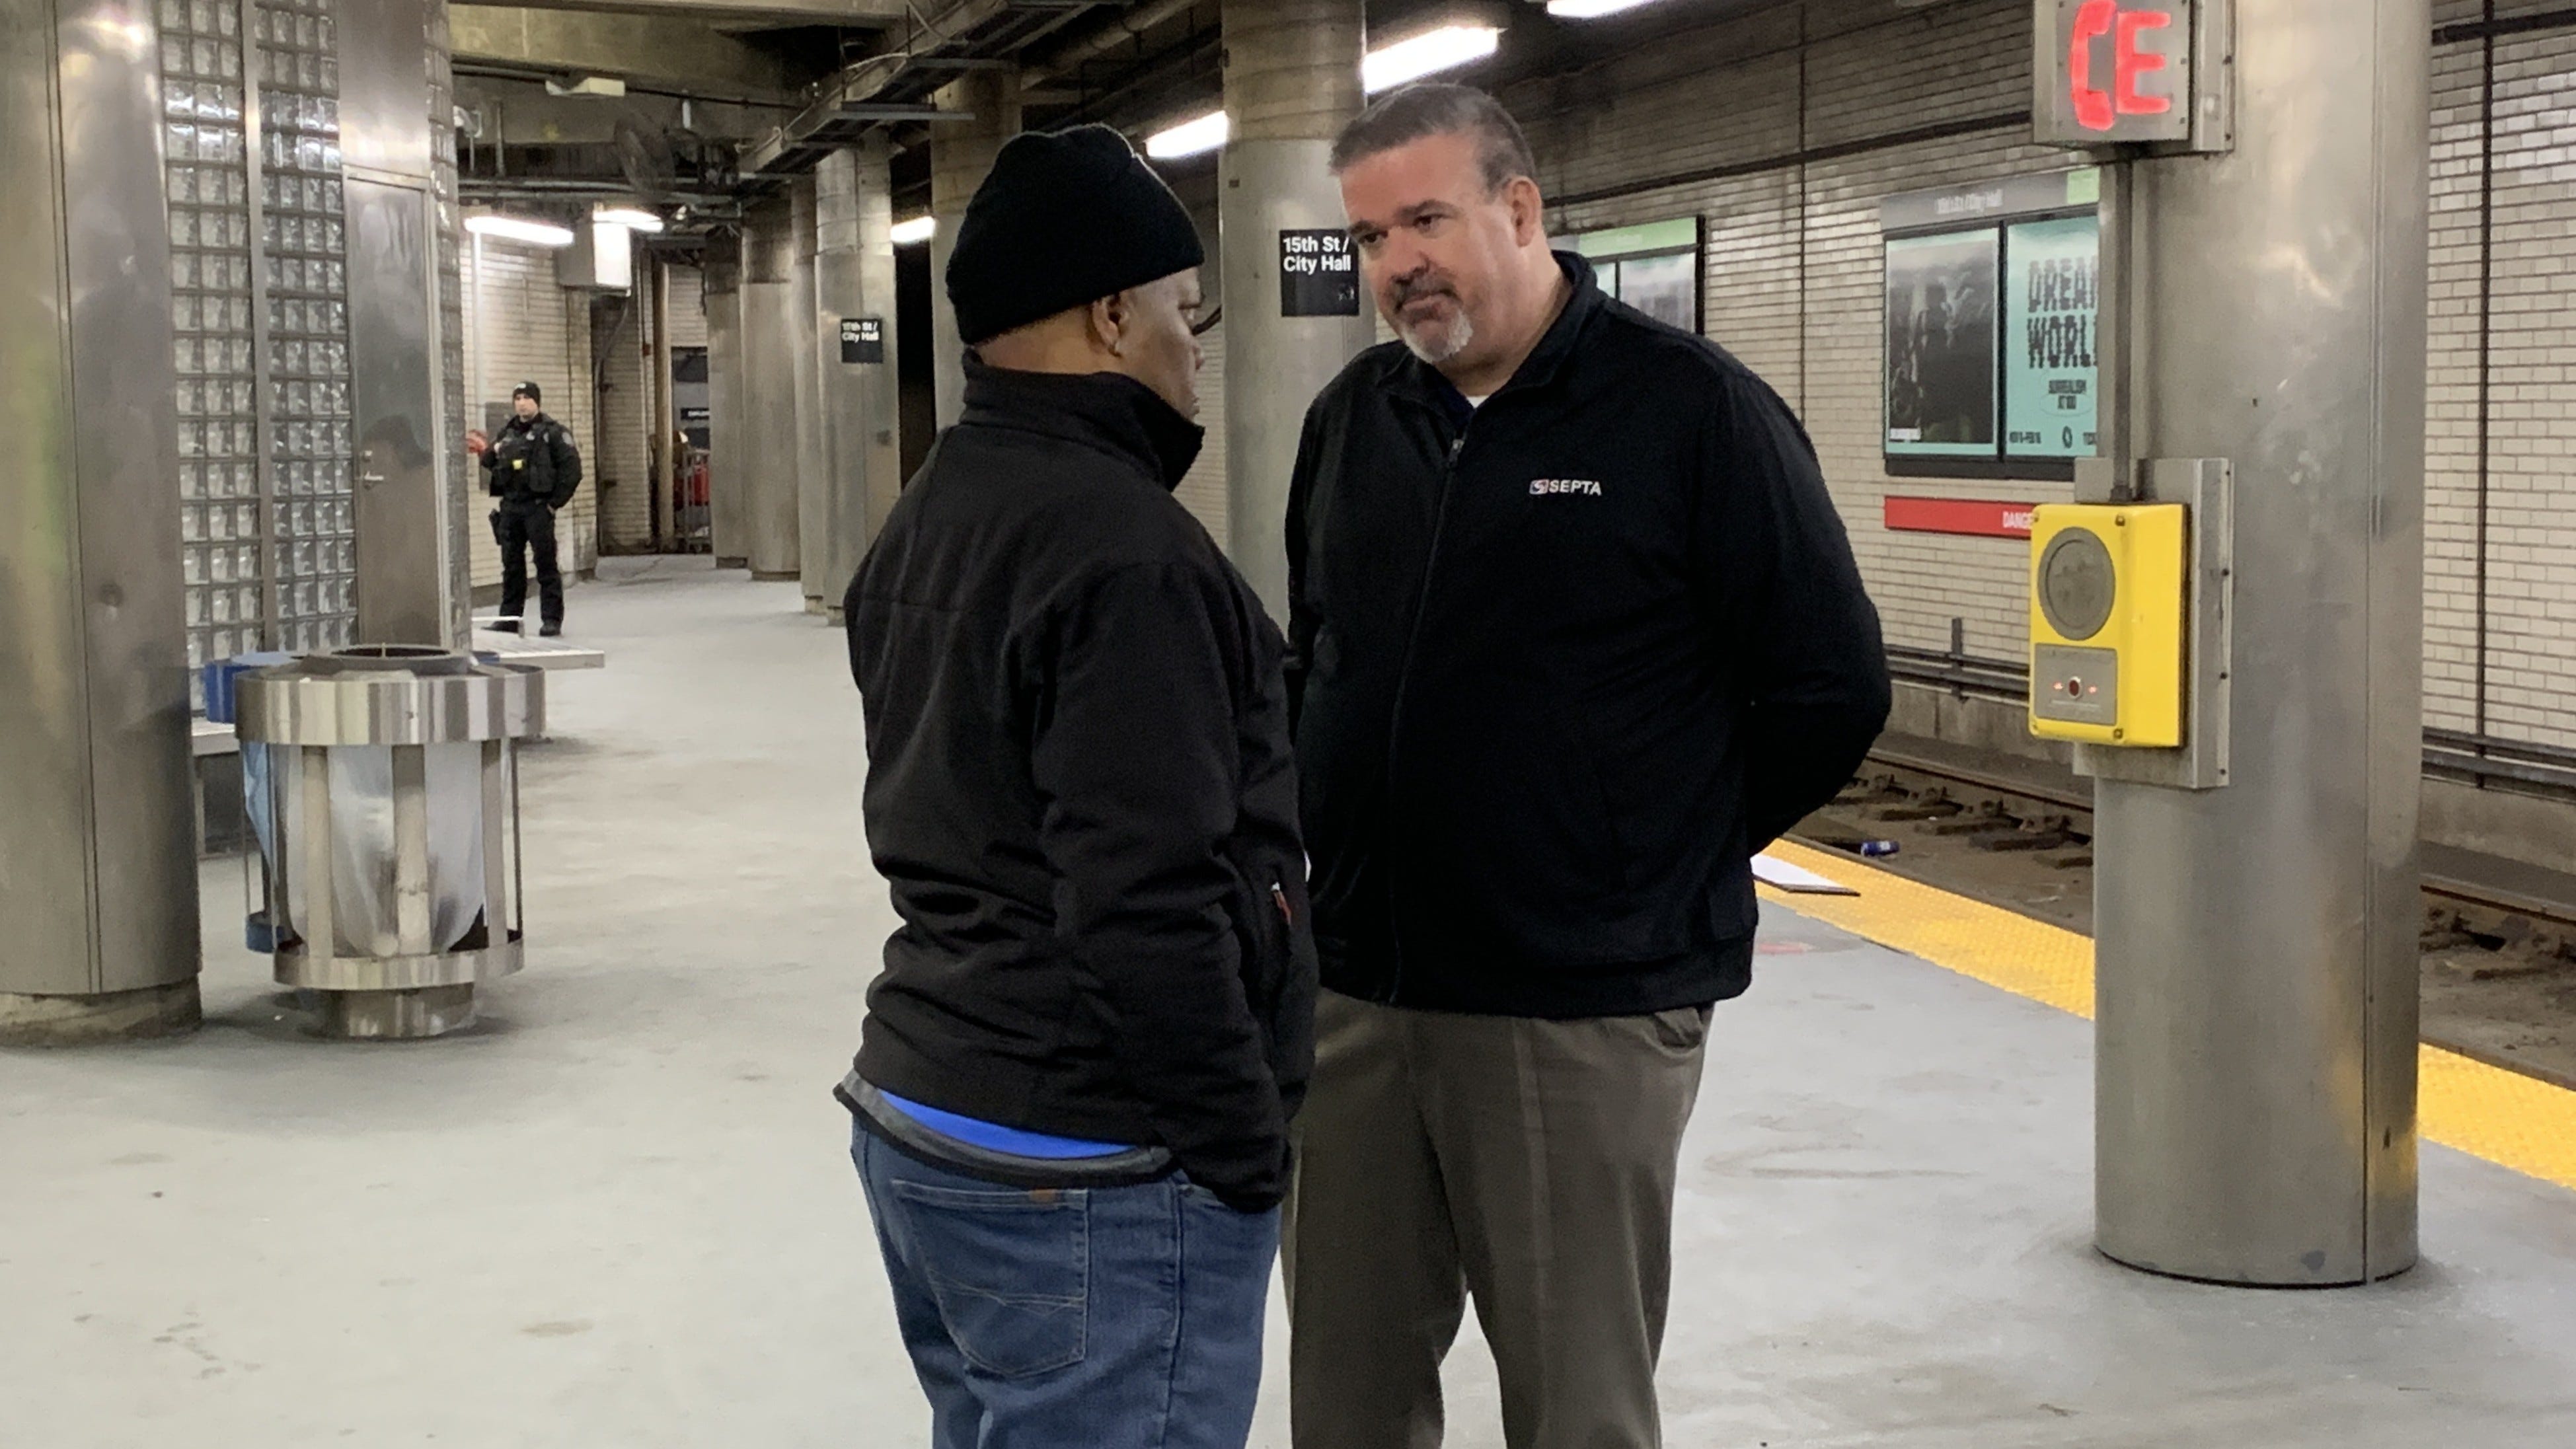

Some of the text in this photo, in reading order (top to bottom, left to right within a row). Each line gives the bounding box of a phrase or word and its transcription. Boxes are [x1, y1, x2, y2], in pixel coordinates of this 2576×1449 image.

[1283, 236, 1318, 253] 15th
[1283, 255, 1351, 276] City Hall
[2027, 315, 2098, 369] WORL
[1548, 479, 1602, 496] SEPTA
[2002, 511, 2033, 530] DANGE
